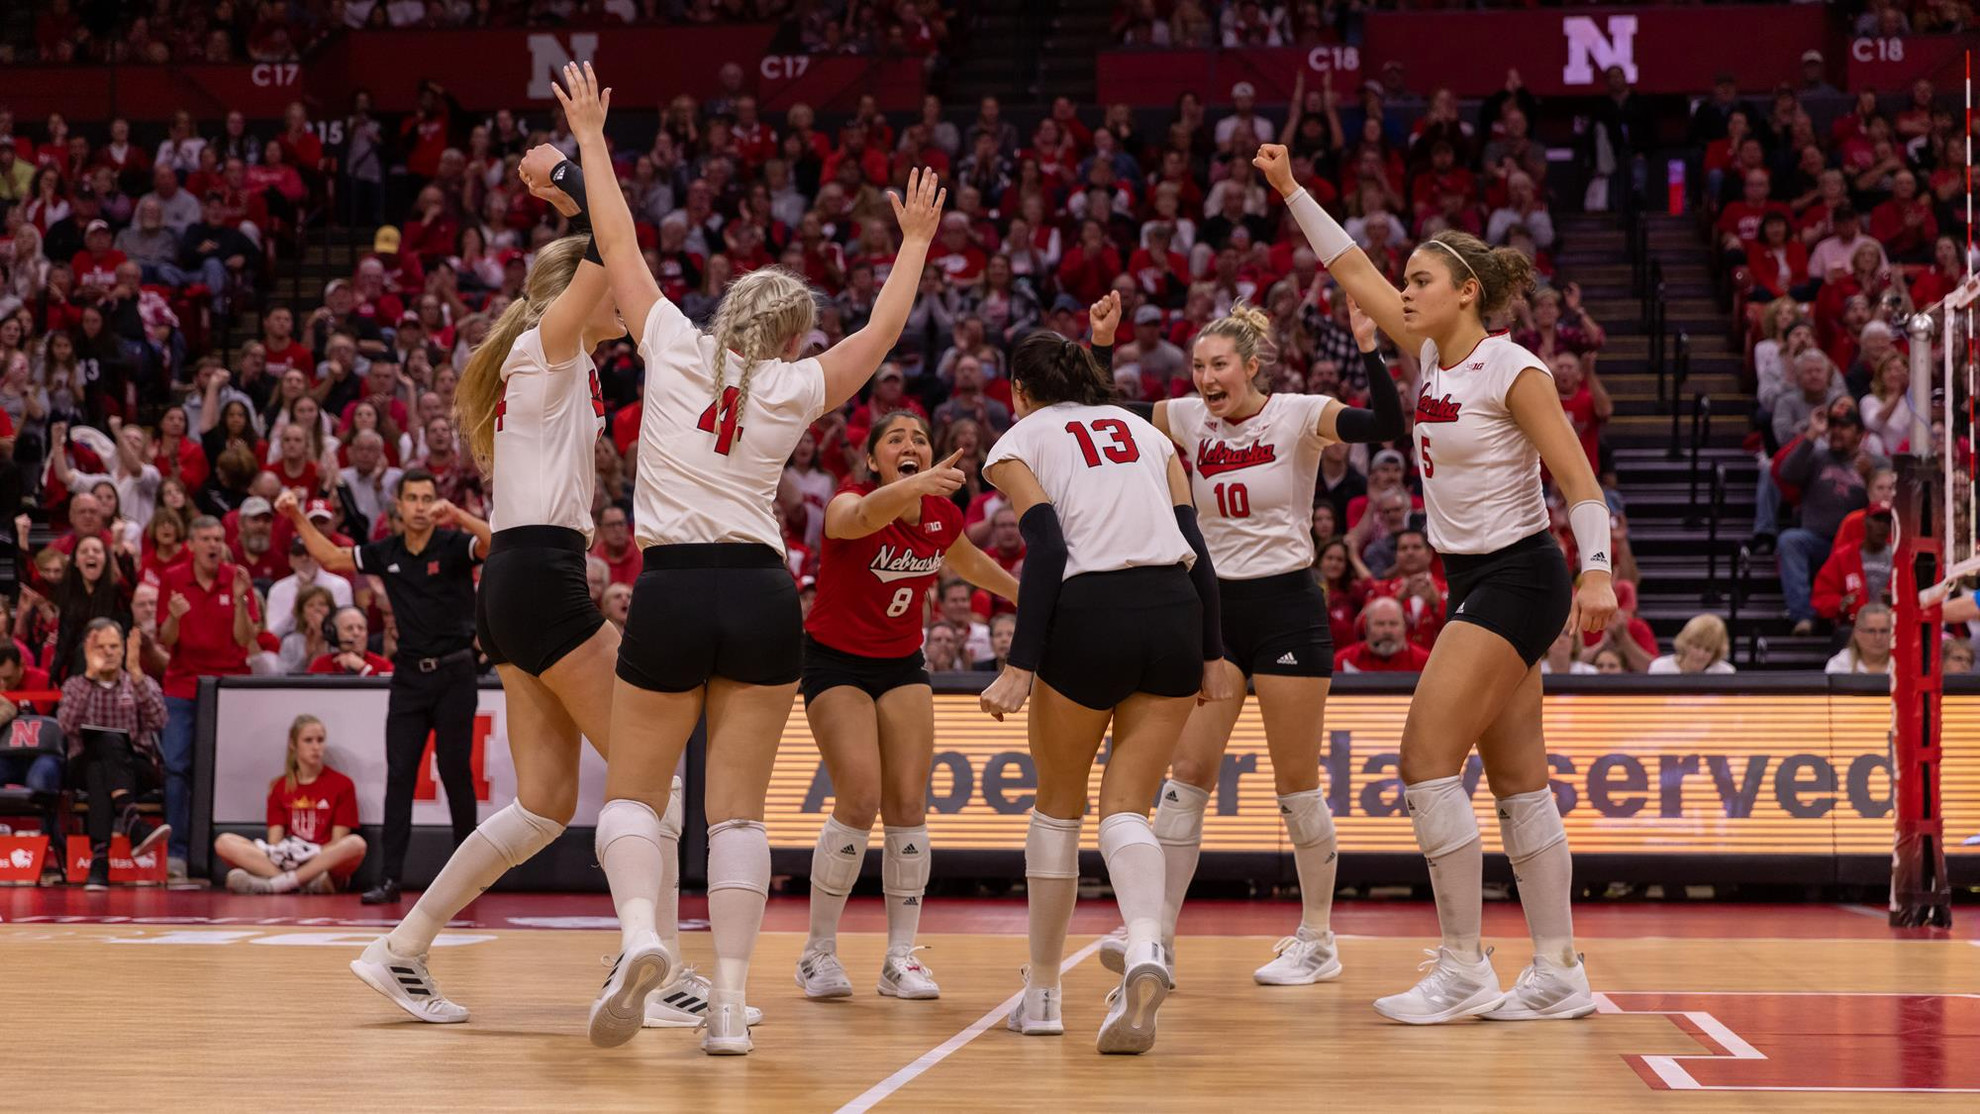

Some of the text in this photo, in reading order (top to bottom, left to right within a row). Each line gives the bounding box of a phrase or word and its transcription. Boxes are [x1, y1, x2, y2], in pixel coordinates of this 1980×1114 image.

[1308, 46, 1360, 71] C18
[1562, 15, 1638, 84] N
[1852, 37, 1904, 62] C18
[251, 63, 299, 87] C17
[527, 33, 598, 99] N
[760, 55, 809, 79] C17
[304, 121, 343, 145] 15
[697, 385, 744, 456] 4
[1065, 418, 1140, 468] 13
[1196, 438, 1276, 469] Nebraska
[1421, 435, 1434, 478] 5
[1214, 483, 1251, 518] 10
[869, 544, 945, 574] Nebrask
[886, 587, 913, 618] 8
[10, 720, 42, 747] N
[1546, 730, 1894, 818] served
